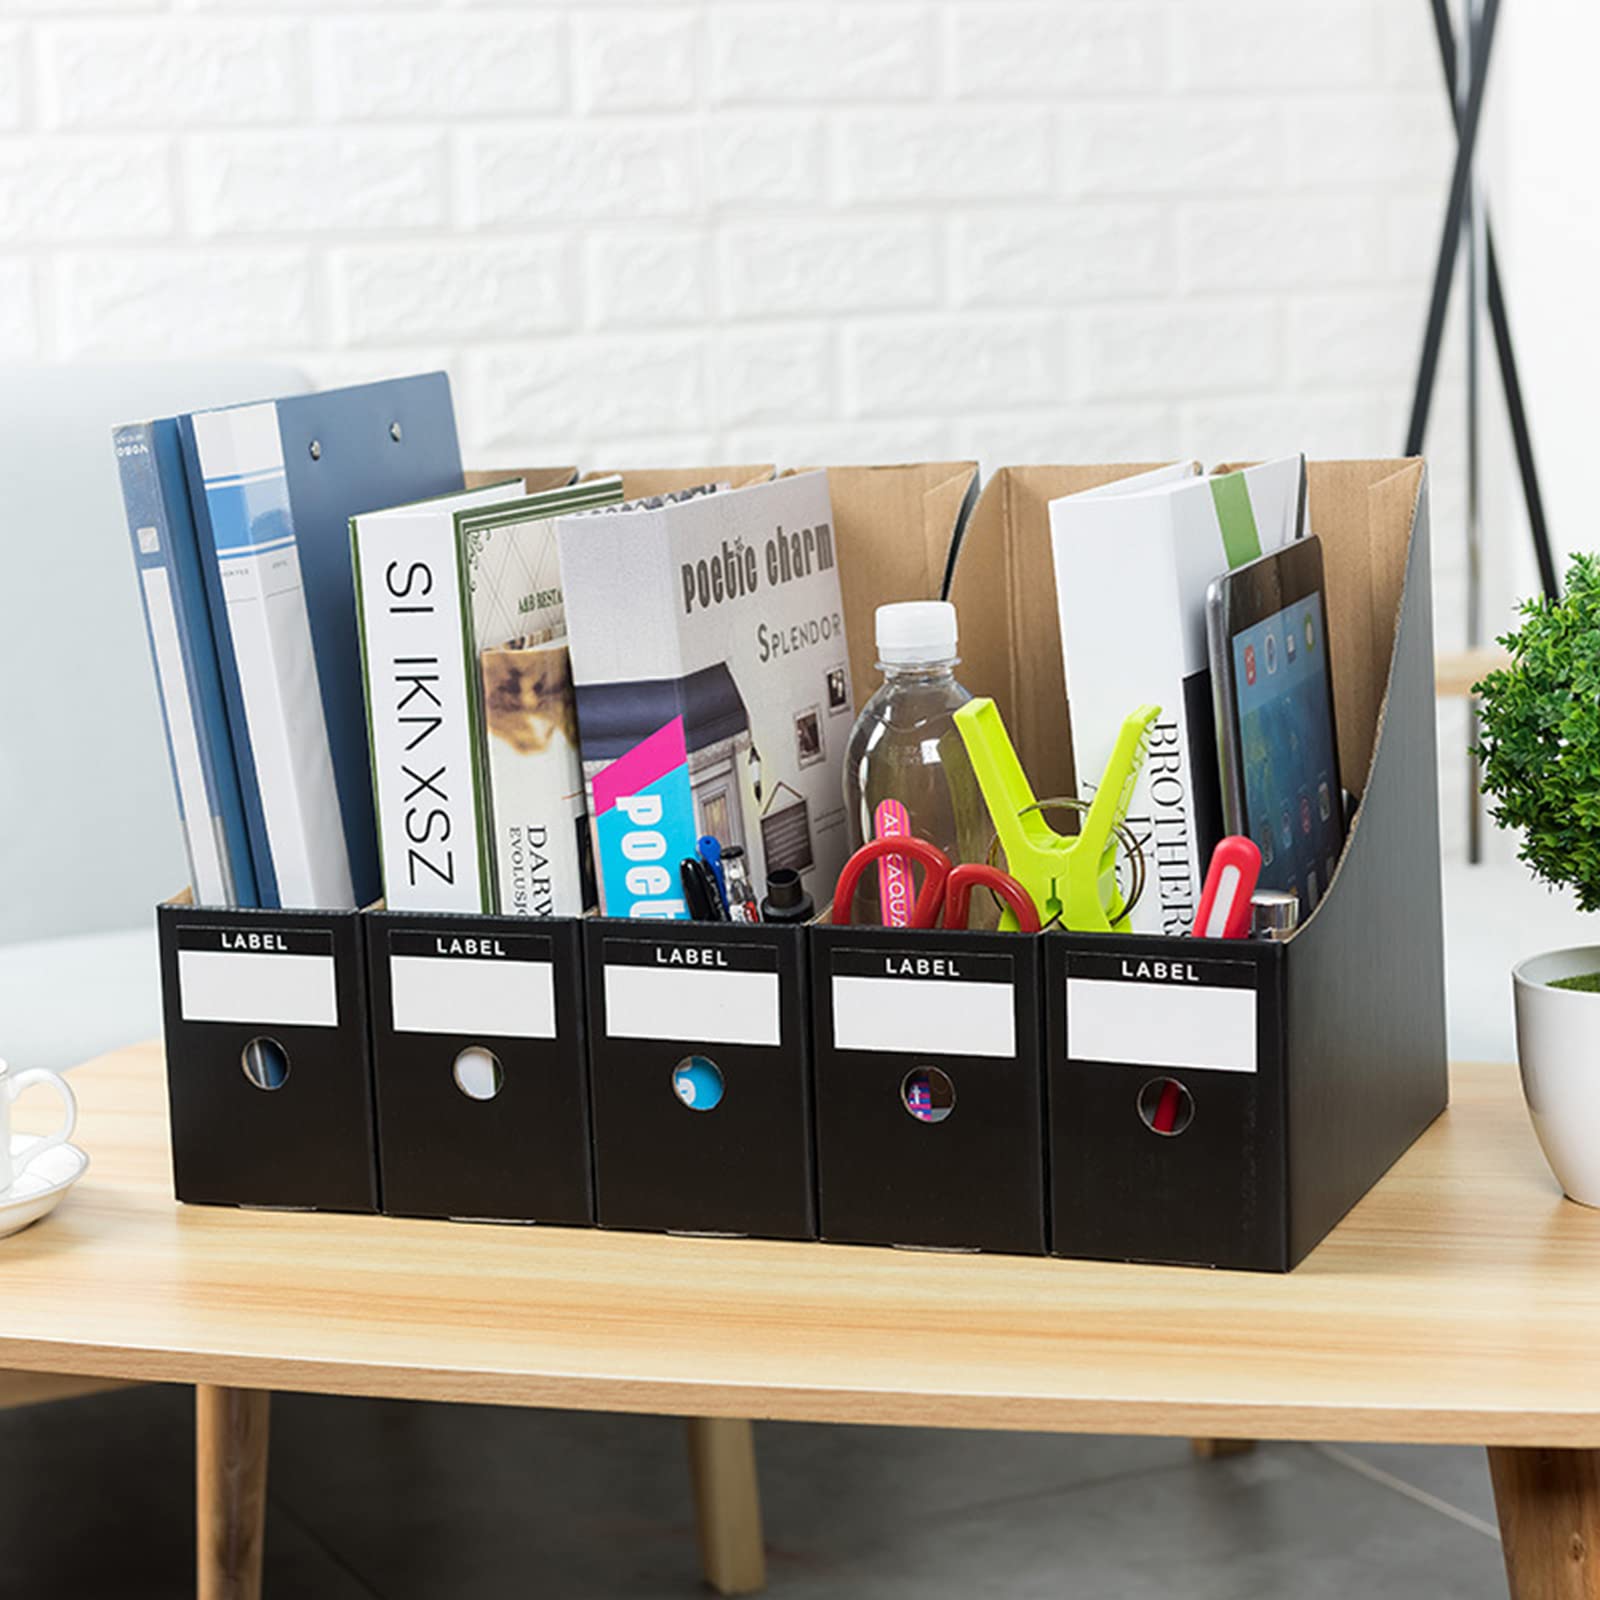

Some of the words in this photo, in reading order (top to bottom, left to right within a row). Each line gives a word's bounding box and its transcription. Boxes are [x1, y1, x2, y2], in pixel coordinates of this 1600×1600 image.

[682, 536, 757, 614] poetic
[766, 523, 834, 586] charm
[387, 561, 434, 613] SI
[401, 766, 454, 886] XSZ
[221, 932, 288, 951] LABEL
[436, 937, 506, 957] LABEL
[655, 947, 728, 967] LABEL
[885, 958, 960, 978] LABEL
[1122, 960, 1199, 983] LABEL
